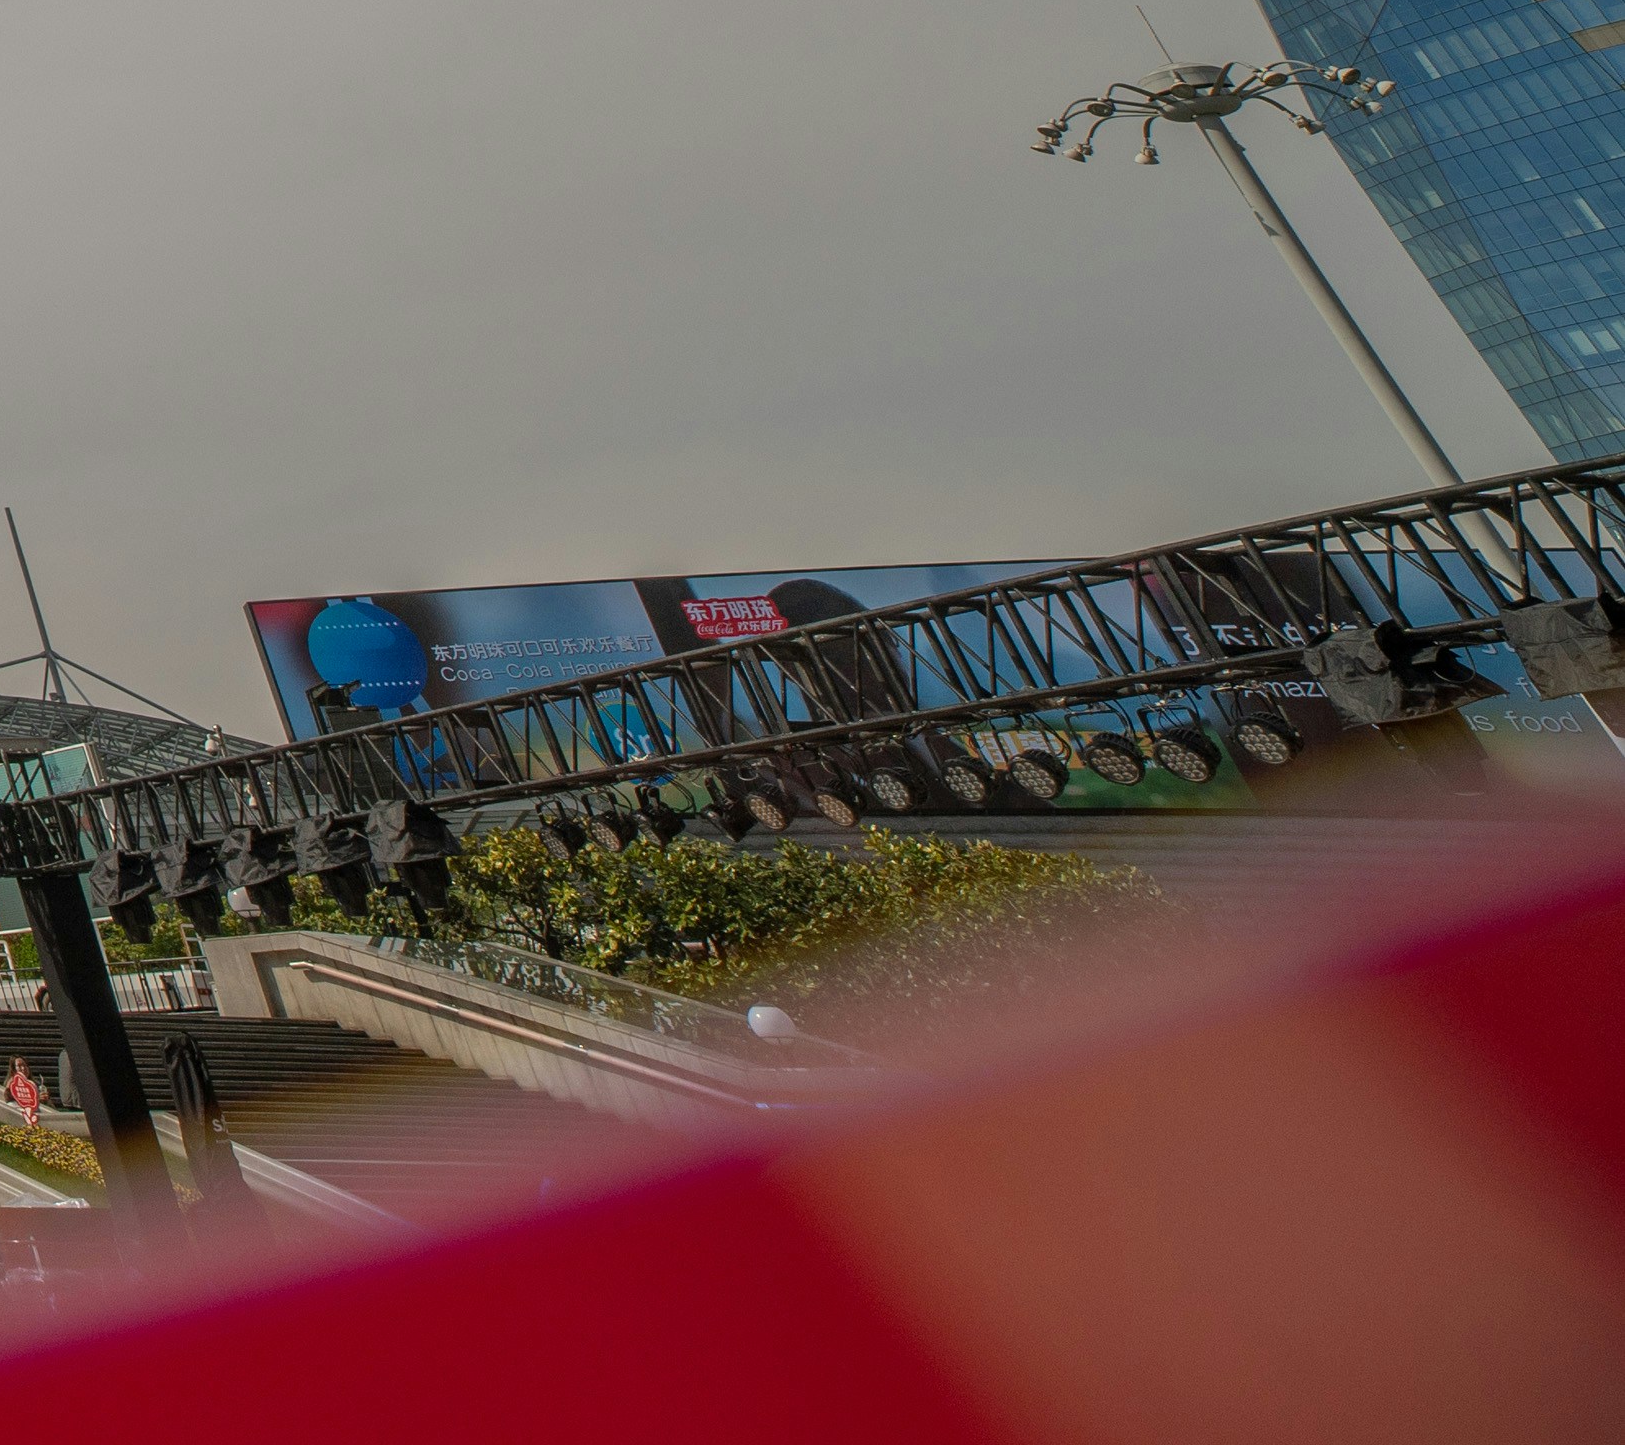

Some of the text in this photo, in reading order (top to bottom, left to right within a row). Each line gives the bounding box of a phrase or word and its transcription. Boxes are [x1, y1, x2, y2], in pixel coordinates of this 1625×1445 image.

[683, 599, 777, 622] 东方明珠
[430, 634, 653, 662] 东方明珠可口可乐欢乐餐厅
[440, 662, 553, 682] Coca-Cola
[1504, 711, 1583, 733] food
